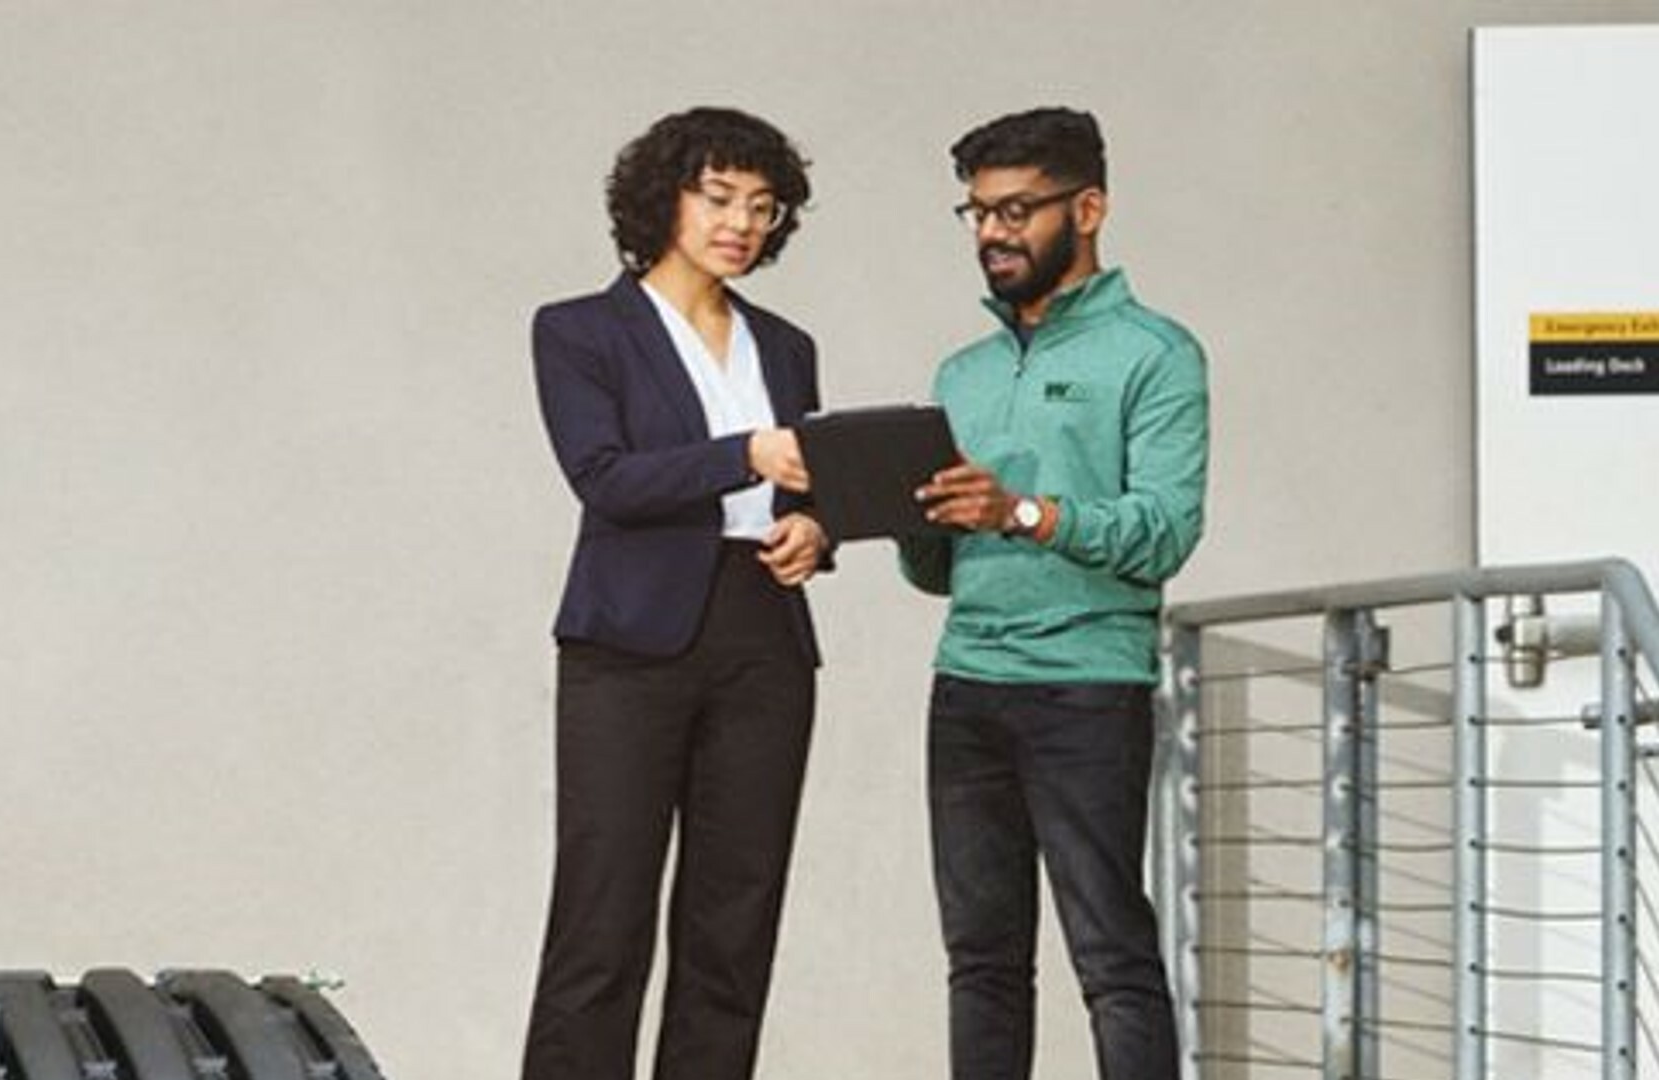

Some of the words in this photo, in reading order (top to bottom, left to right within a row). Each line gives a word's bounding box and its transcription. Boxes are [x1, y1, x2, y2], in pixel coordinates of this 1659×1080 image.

[1545, 317, 1626, 336] Emergency
[1545, 357, 1605, 376] Loading
[1607, 357, 1645, 374] Dock
